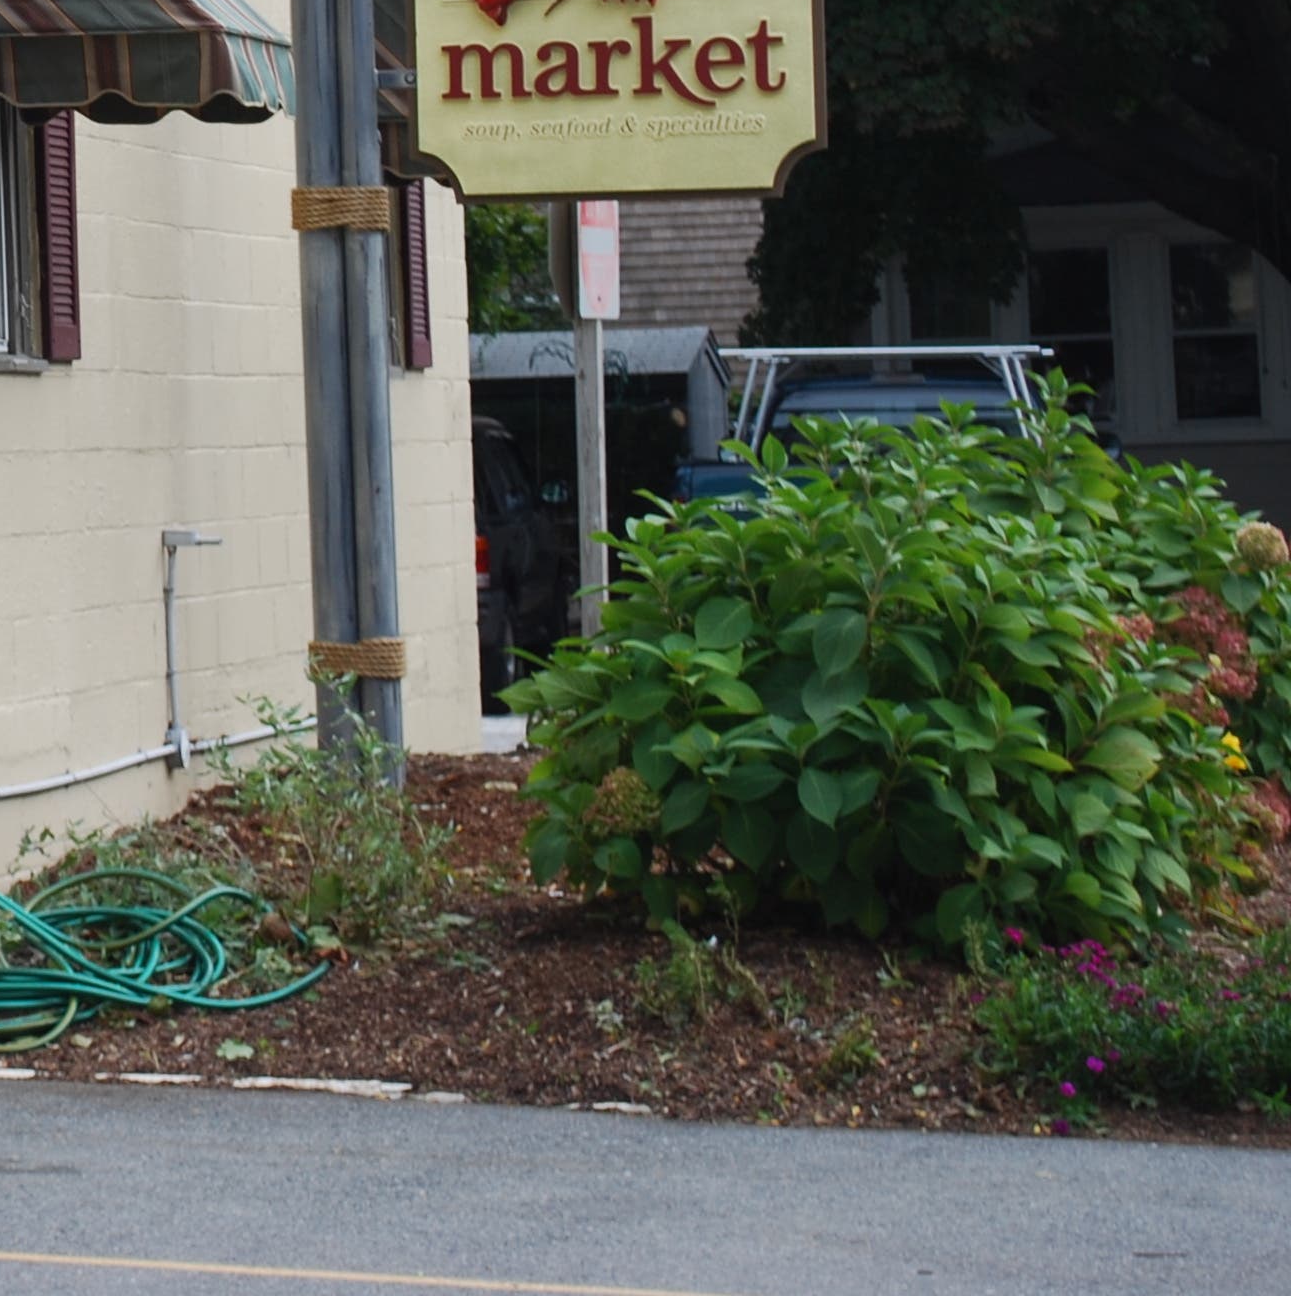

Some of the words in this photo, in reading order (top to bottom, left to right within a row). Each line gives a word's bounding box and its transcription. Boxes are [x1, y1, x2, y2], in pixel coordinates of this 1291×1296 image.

[440, 15, 787, 107] market
[463, 117, 522, 141] soup,
[528, 116, 613, 140] seafood
[619, 114, 637, 135] &
[644, 111, 766, 138] specialties
